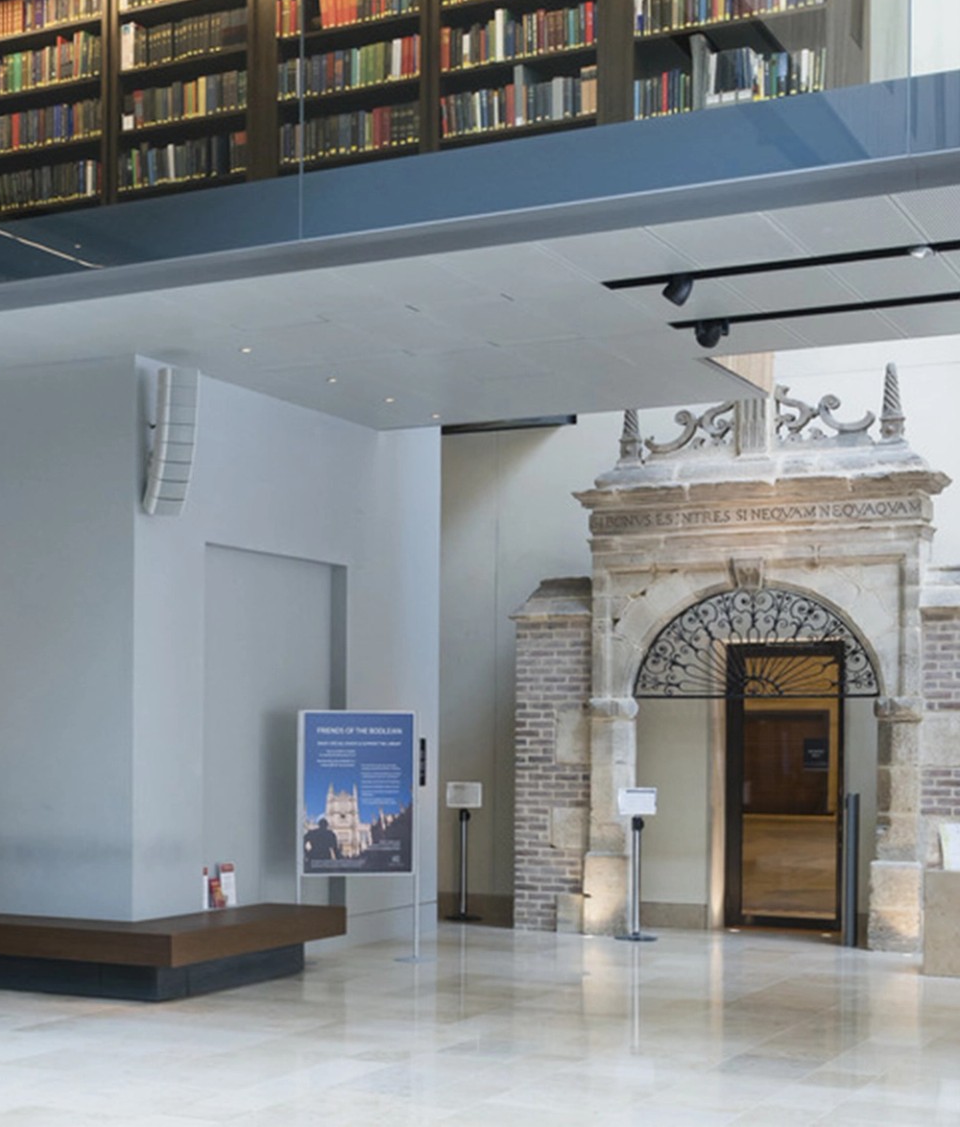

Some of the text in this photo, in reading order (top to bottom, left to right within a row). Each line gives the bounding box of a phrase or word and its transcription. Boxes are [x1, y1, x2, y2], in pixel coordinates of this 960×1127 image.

[605, 513, 652, 528] BONVS
[656, 512, 674, 526] ES
[736, 508, 748, 521] SI
[751, 504, 817, 521] NEQVAM
[819, 498, 922, 518] NEQVAQVAM
[317, 726, 344, 735] FRIENDS
[344, 726, 354, 735] OF
[355, 726, 367, 735] THE
